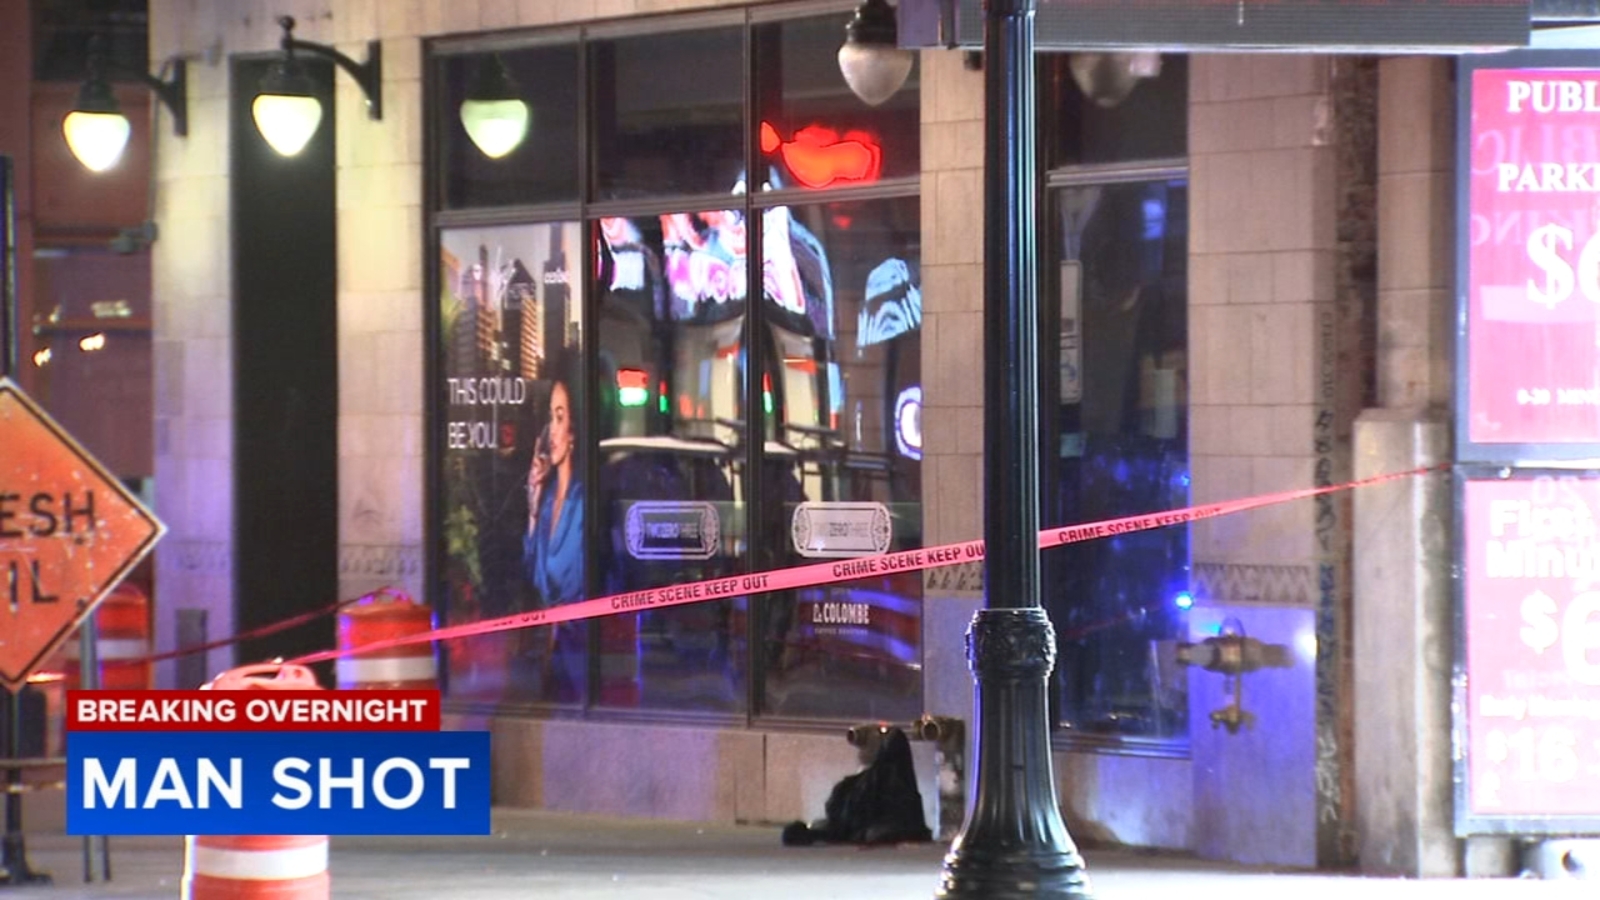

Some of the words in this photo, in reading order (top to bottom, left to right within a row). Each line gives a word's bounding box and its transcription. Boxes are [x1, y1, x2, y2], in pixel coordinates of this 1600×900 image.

[447, 377, 477, 404] THIS
[479, 377, 526, 404] COULD
[448, 422, 466, 449] BE
[1058, 525, 1105, 544] CRIME
[1107, 519, 1151, 536] SCENE
[833, 558, 877, 578] CRIME
[880, 552, 922, 572] SCENE
[927, 546, 961, 564] KEEP
[965, 543, 985, 559] OU
[611, 590, 655, 610] CRIME
[658, 584, 700, 603] SCENE
[704, 578, 737, 596] KEEP
[742, 574, 770, 590] OUT
[823, 602, 870, 625] COLOMBE
